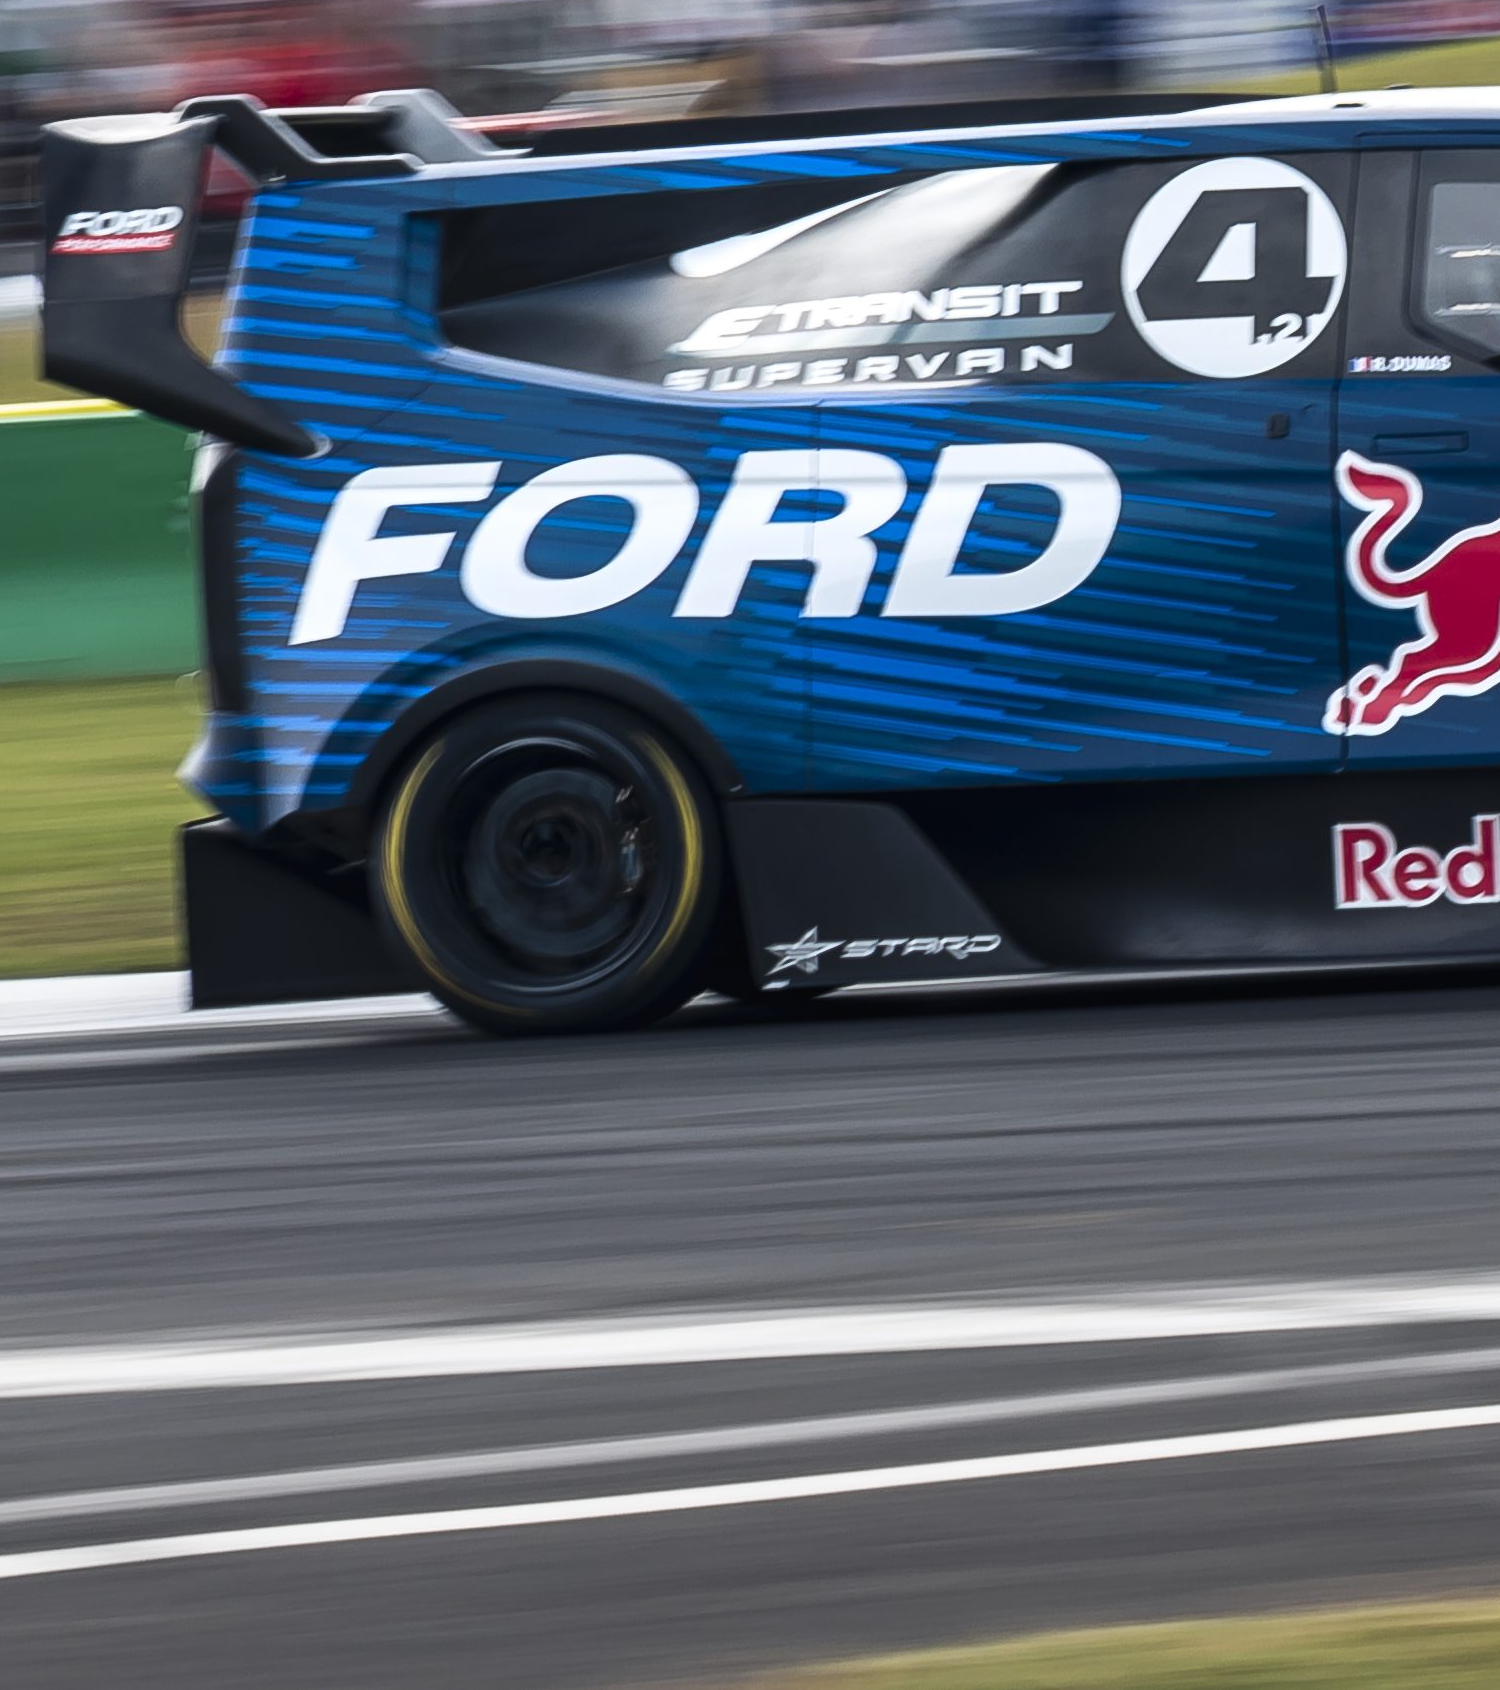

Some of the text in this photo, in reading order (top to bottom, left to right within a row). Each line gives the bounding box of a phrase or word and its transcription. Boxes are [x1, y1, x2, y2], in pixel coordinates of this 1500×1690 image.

[58, 206, 183, 236] FORD
[663, 343, 1074, 391] SUPERVAN
[288, 442, 1122, 646] FORD
[840, 935, 1001, 959] STARD
